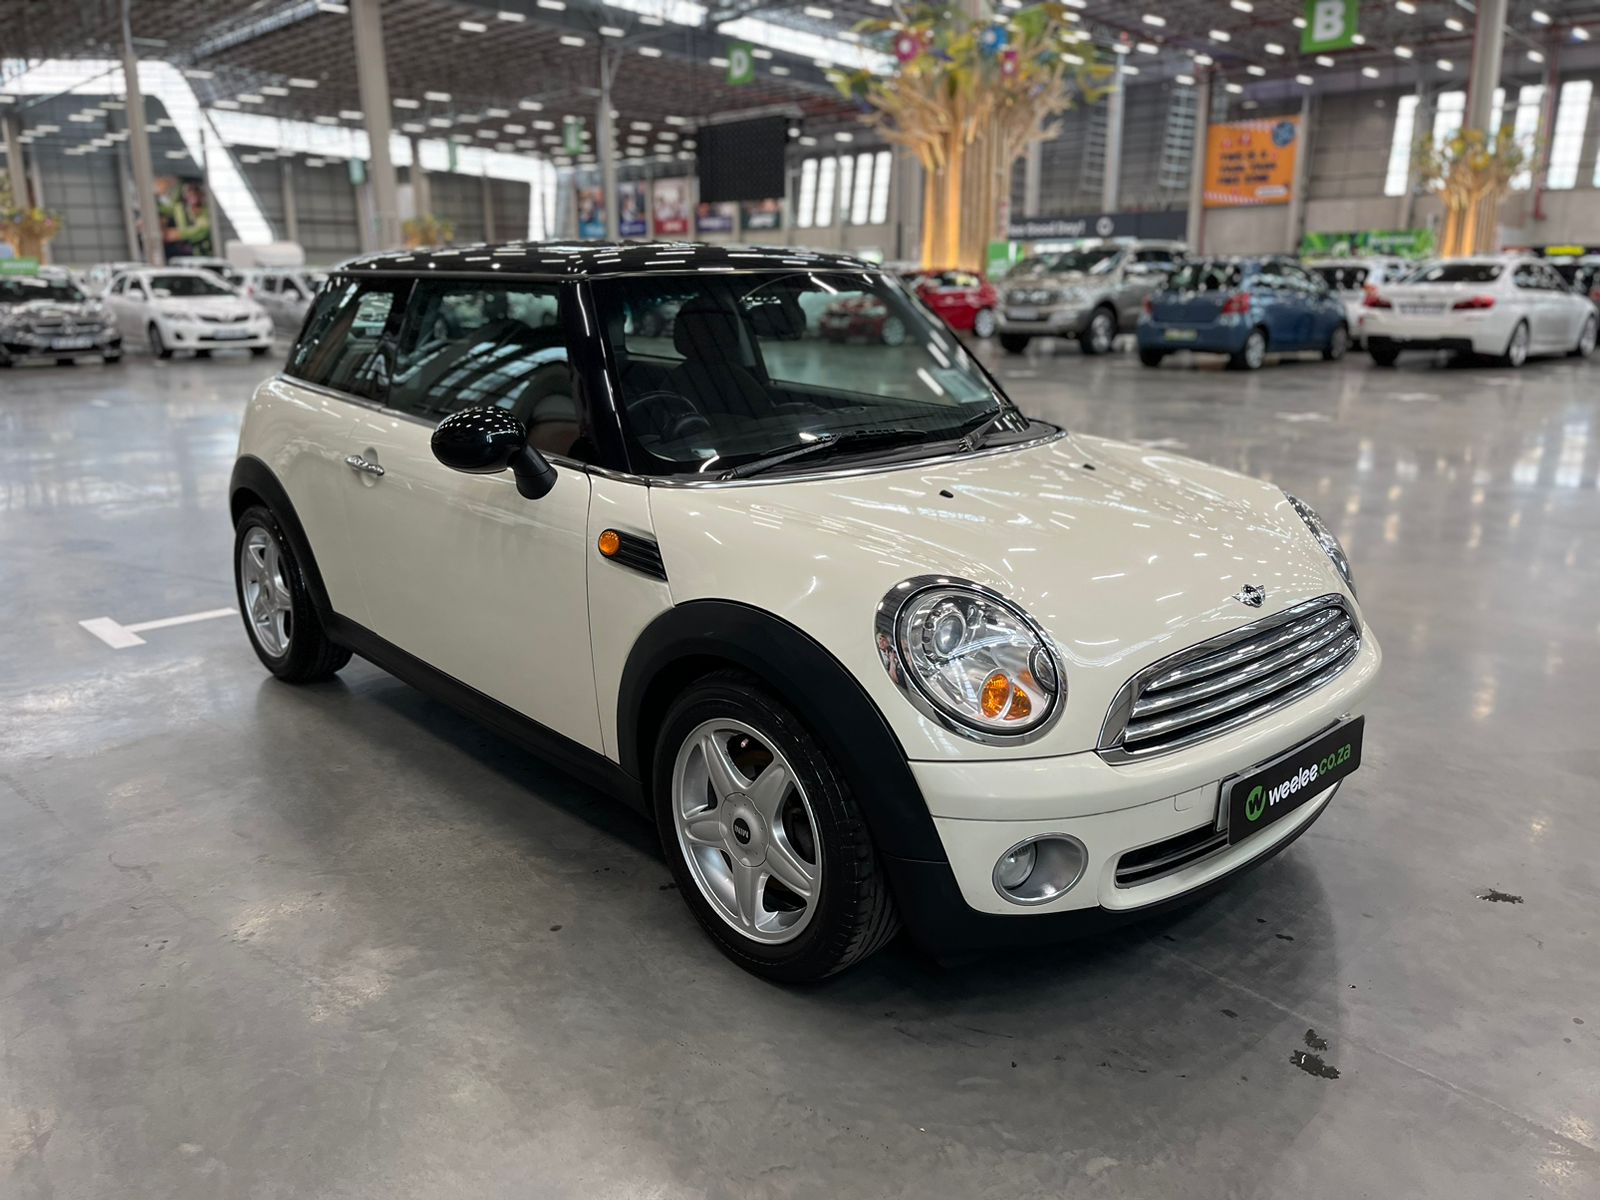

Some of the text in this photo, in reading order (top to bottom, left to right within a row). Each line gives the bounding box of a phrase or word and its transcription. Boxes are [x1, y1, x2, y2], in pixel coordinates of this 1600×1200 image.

[1313, 0, 1346, 41] B
[730, 48, 749, 78] D
[1268, 743, 1351, 806] weelee.co.za
